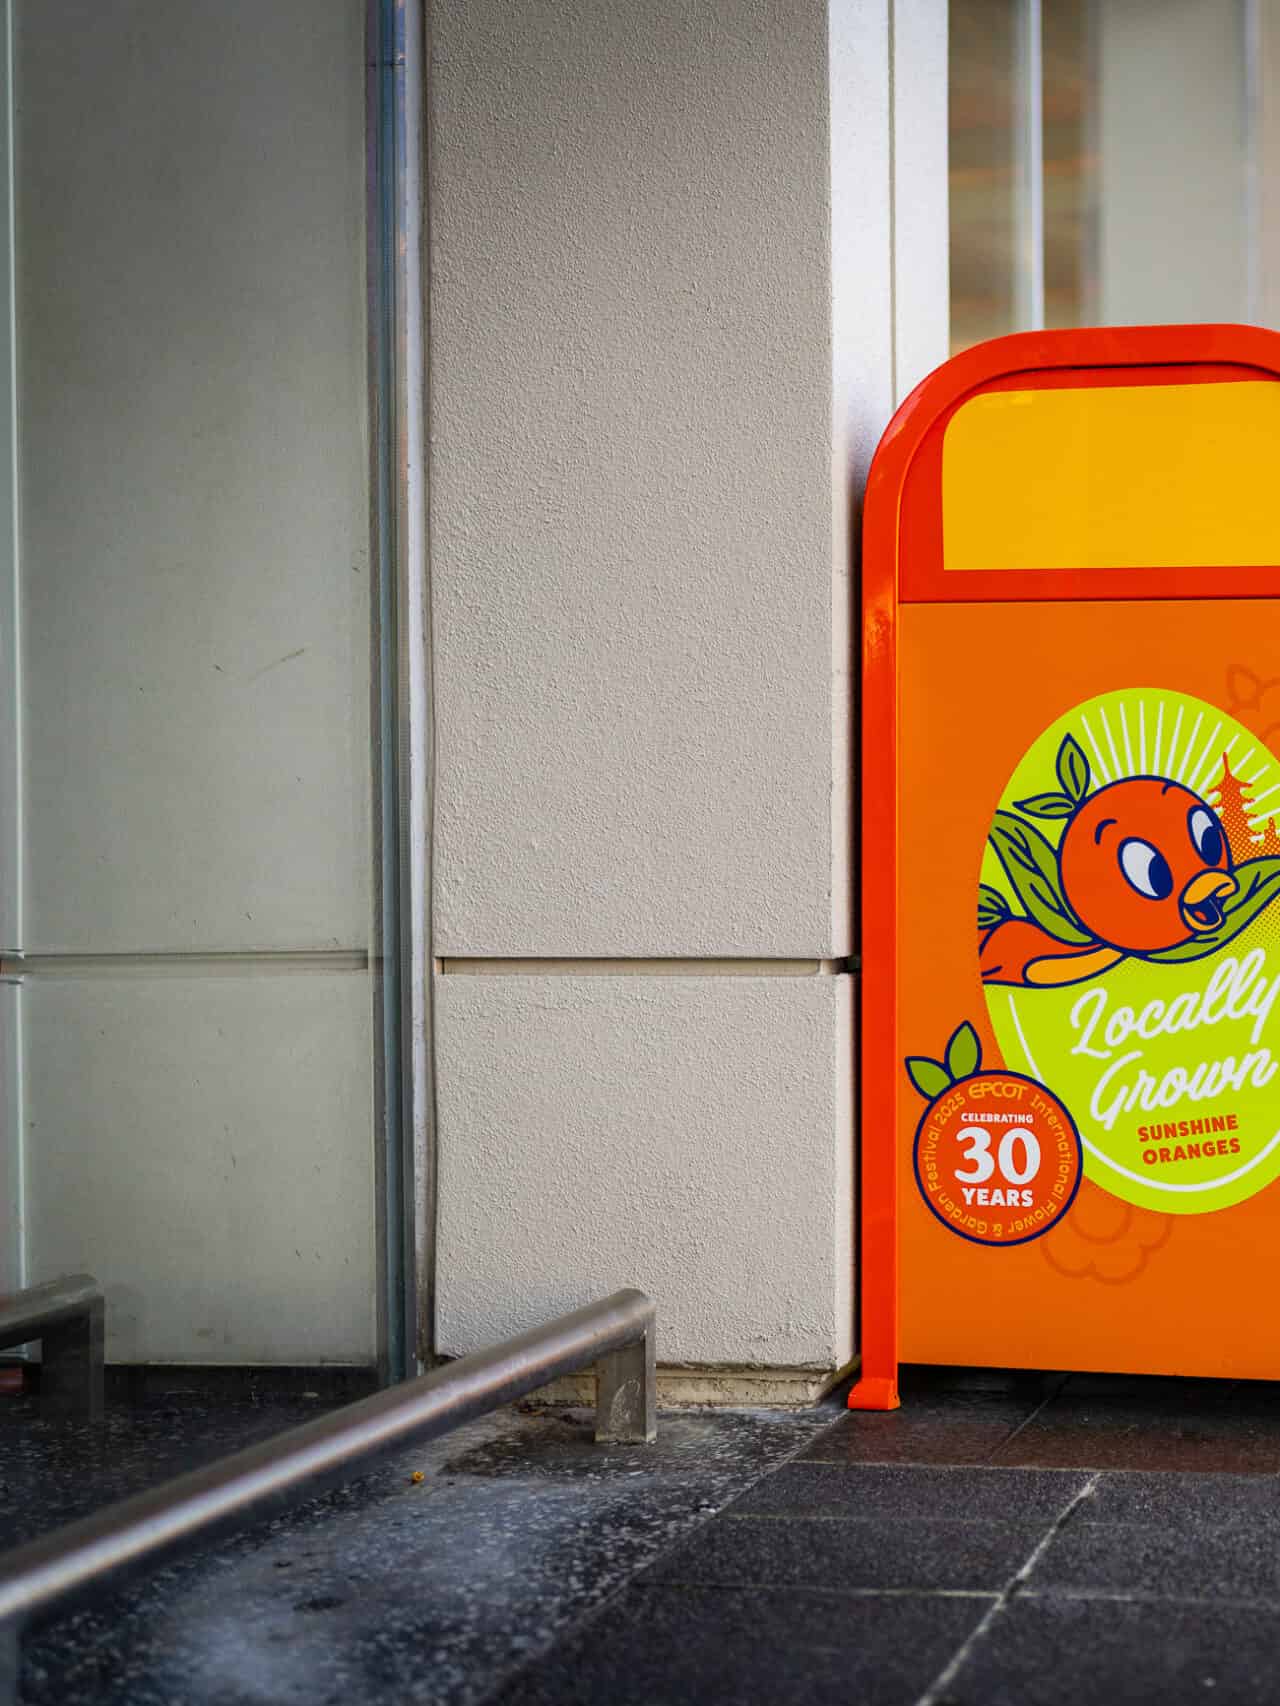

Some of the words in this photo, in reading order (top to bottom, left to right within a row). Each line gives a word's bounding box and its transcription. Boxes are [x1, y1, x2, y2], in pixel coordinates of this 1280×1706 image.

[968, 1081, 1029, 1100] EPCOT
[1089, 1047, 1279, 1131] Grown
[934, 1092, 966, 1126] 2025
[961, 1112, 1034, 1124] CELEBRATING
[1137, 1114, 1239, 1143] SUNSHINE
[922, 1126, 942, 1192] Festival
[954, 1126, 1041, 1185] 30
[1030, 1094, 1073, 1200] International
[1142, 1137, 1241, 1165] ORANGES
[938, 1192, 988, 1234] Garden
[961, 1188, 1034, 1207] YEARS
[992, 1223, 1003, 1236] &
[1008, 1200, 1057, 1233] Flower
